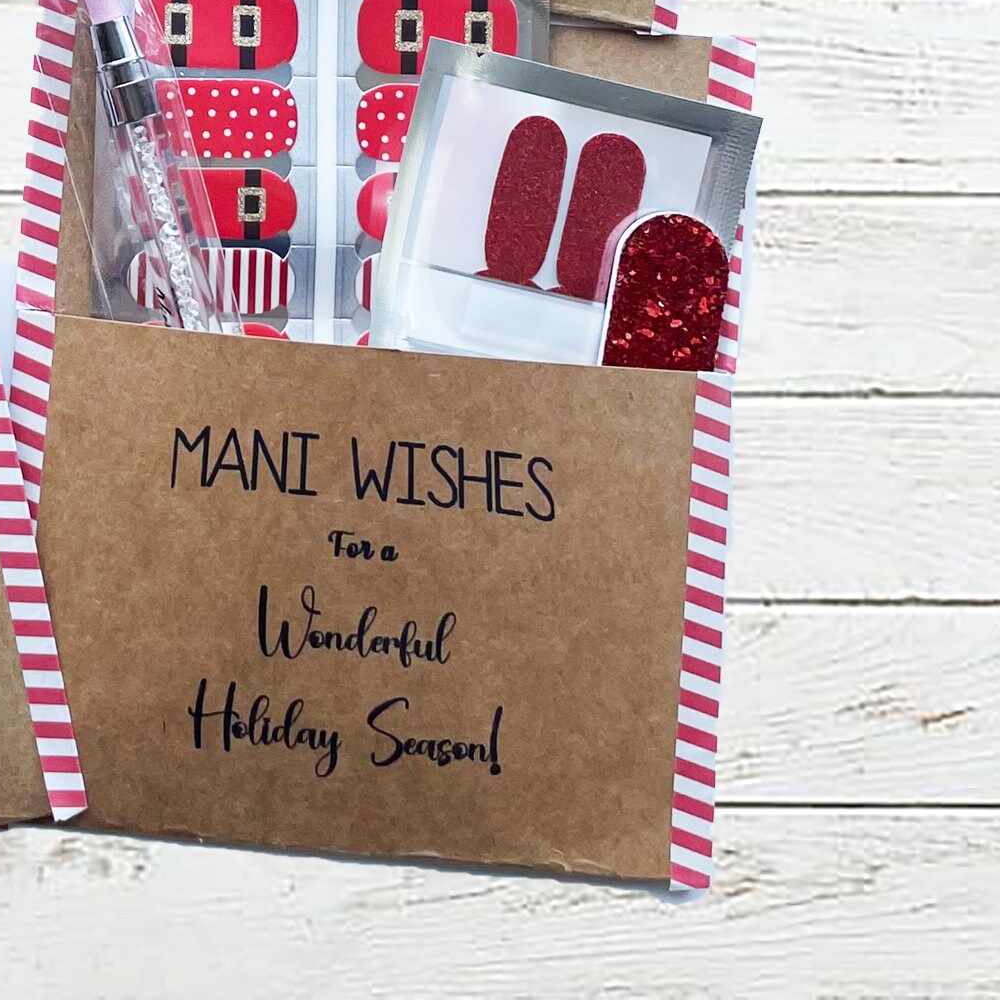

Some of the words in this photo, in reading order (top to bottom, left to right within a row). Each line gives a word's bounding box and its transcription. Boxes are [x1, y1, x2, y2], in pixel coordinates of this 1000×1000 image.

[171, 425, 320, 496] MANI
[351, 436, 555, 522] WISHES
[328, 530, 375, 558] For
[381, 545, 399, 562] a
[258, 585, 457, 668] Wonderful
[188, 678, 342, 778] Holiday
[367, 697, 503, 776] Season!
